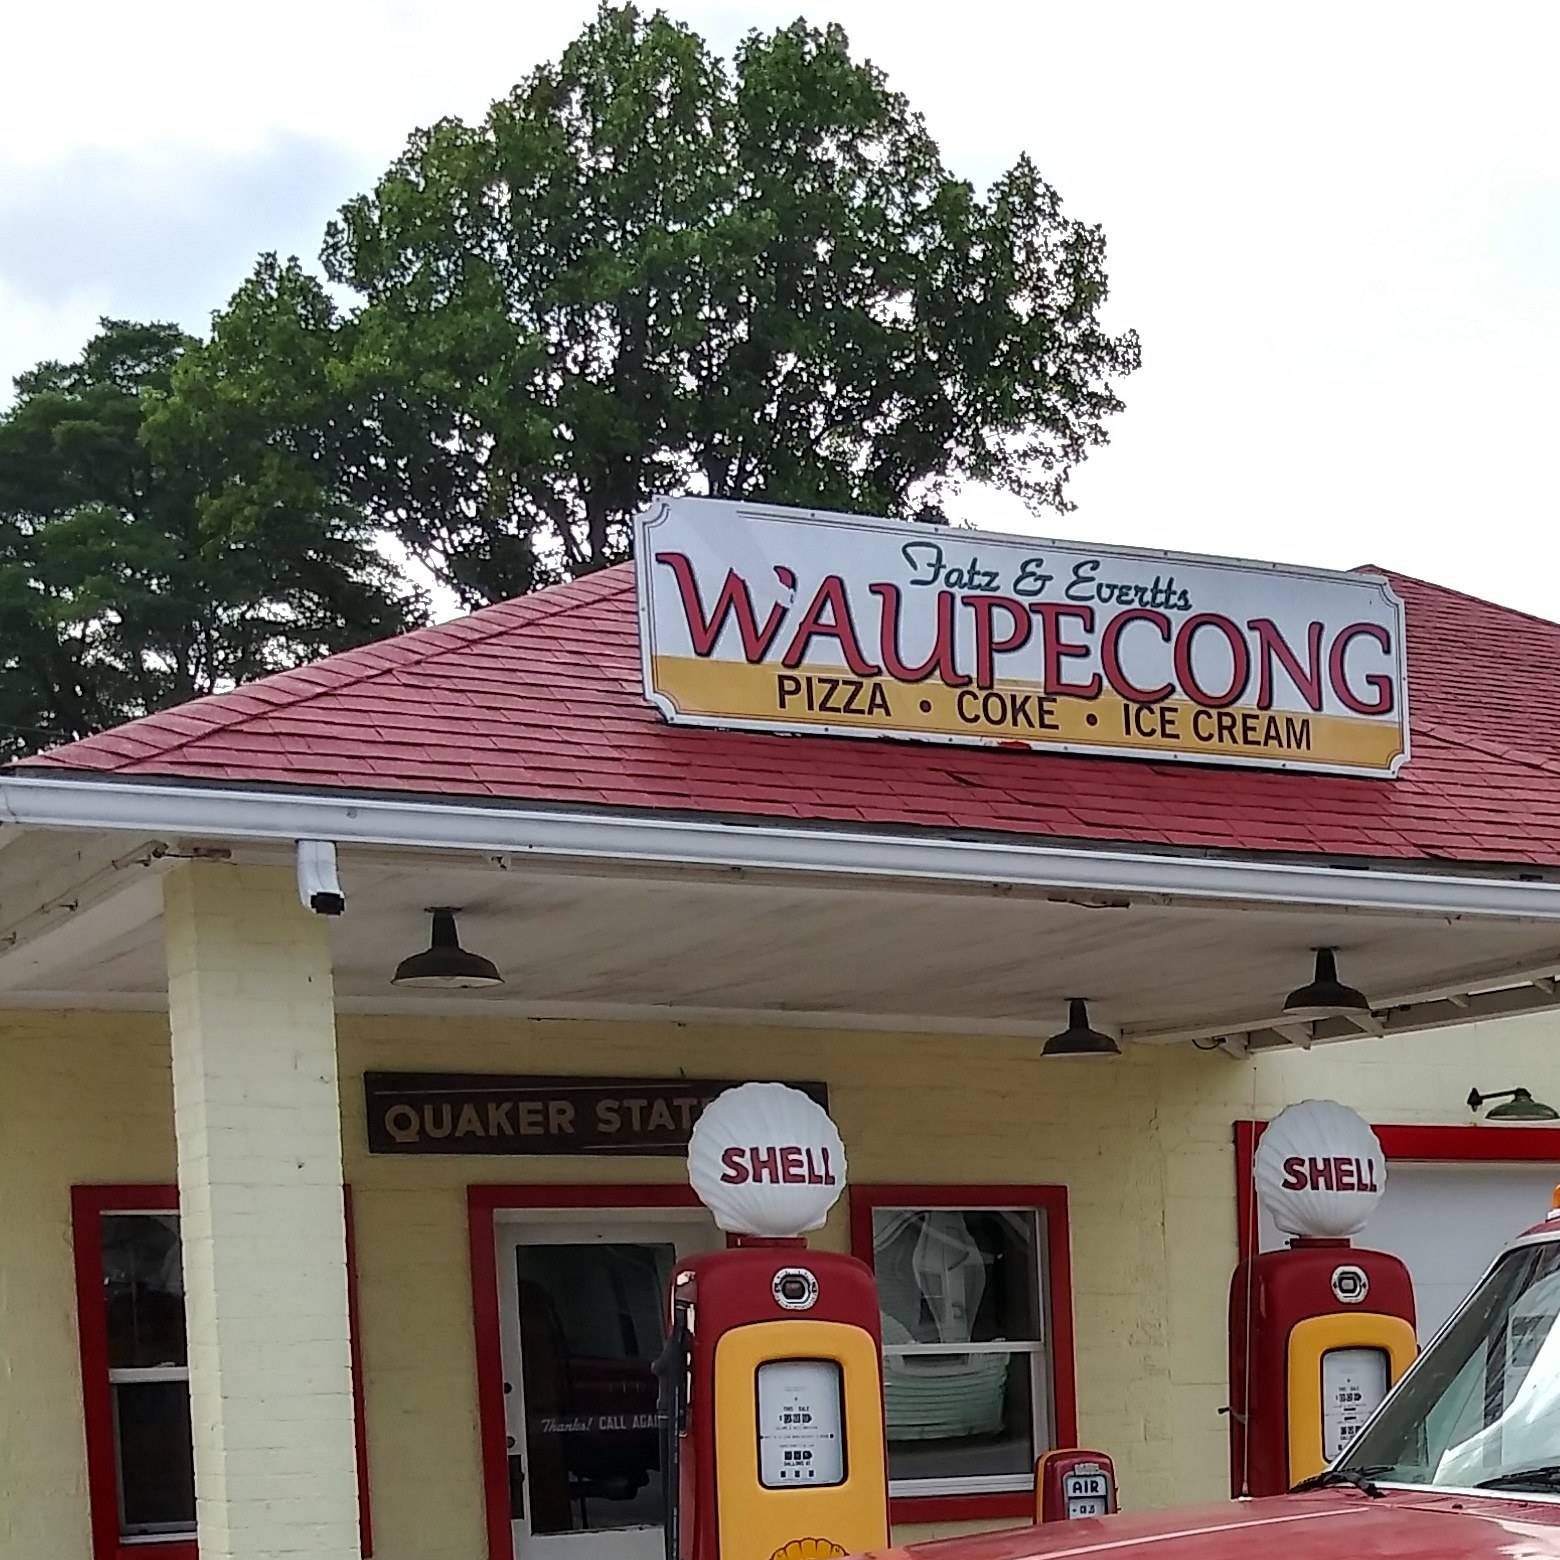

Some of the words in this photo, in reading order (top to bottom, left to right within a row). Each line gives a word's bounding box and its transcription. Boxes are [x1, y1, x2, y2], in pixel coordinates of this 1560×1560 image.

[902, 541, 1000, 592] Fatz
[1013, 557, 1053, 597] &
[655, 551, 1396, 716] WAUPECONG
[777, 674, 892, 717] PIZZA
[956, 689, 1060, 731] COKE
[1123, 702, 1181, 740] ICE
[1192, 709, 1312, 751] CREAM
[384, 1101, 576, 1143] QUAKER
[596, 1097, 711, 1134] STAT
[720, 1146, 837, 1186] SHELL
[1281, 1156, 1378, 1193] SHELL
[541, 1416, 593, 1433] Thanks!
[599, 1415, 627, 1431] CALL
[632, 1413, 660, 1429] AGAI
[1072, 1480, 1099, 1493] AIR
